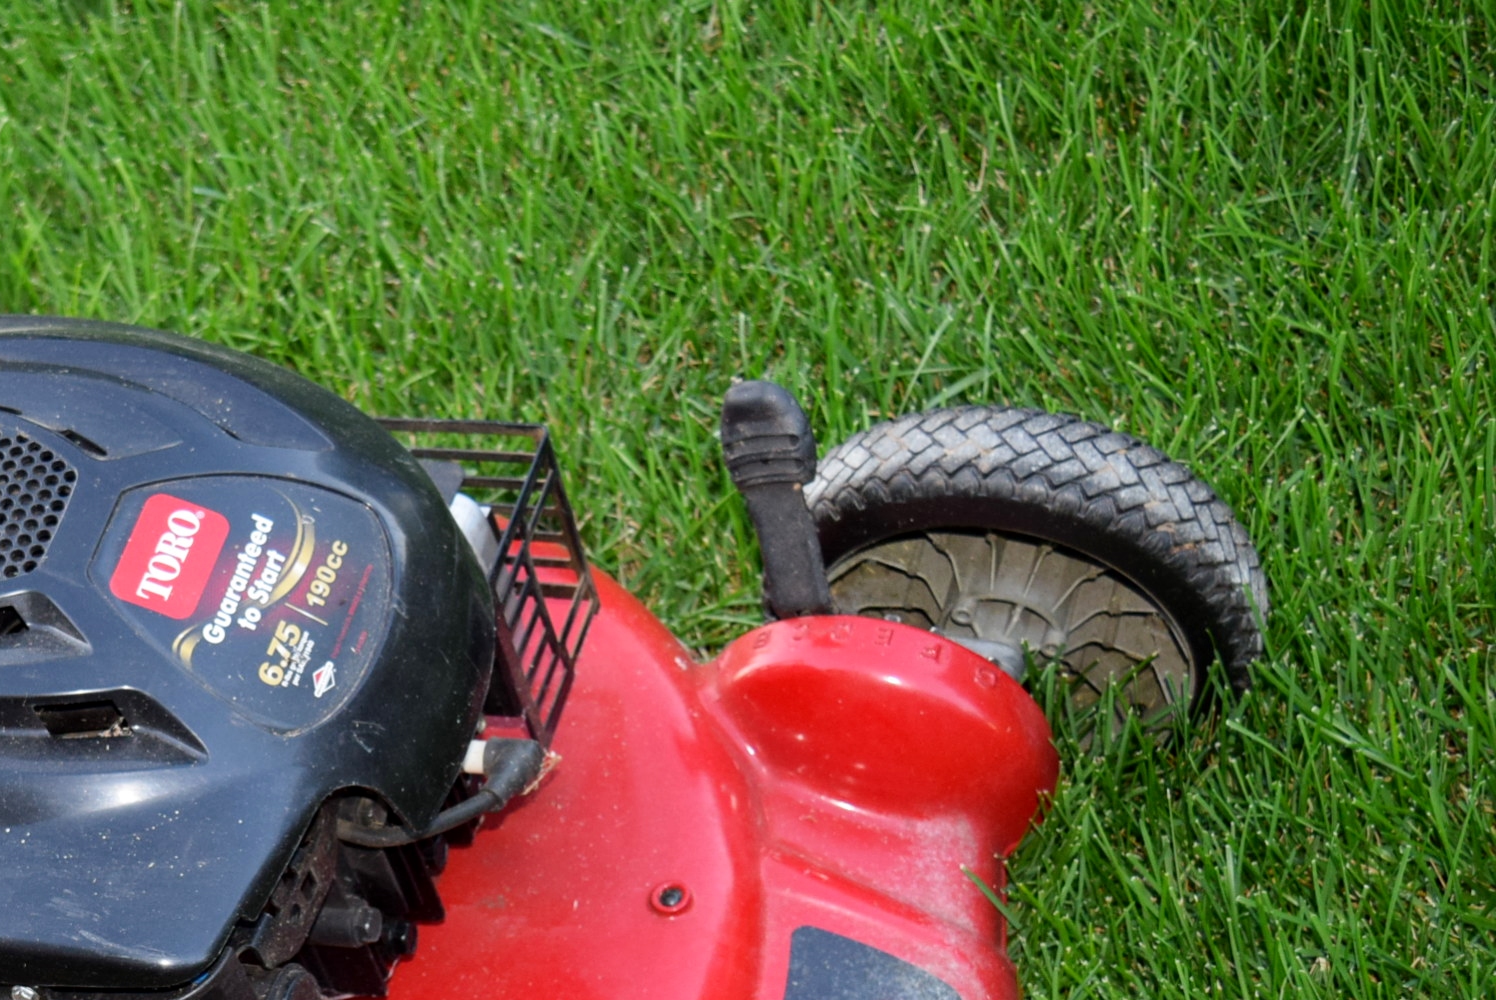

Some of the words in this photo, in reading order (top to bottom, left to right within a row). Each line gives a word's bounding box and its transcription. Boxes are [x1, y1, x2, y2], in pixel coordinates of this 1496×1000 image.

[136, 509, 201, 601] TORO
[203, 513, 273, 644] Guaranteed
[238, 608, 262, 631] to
[251, 549, 286, 604] Start
[259, 620, 302, 686] 6.75
[306, 540, 348, 607] 190cc
